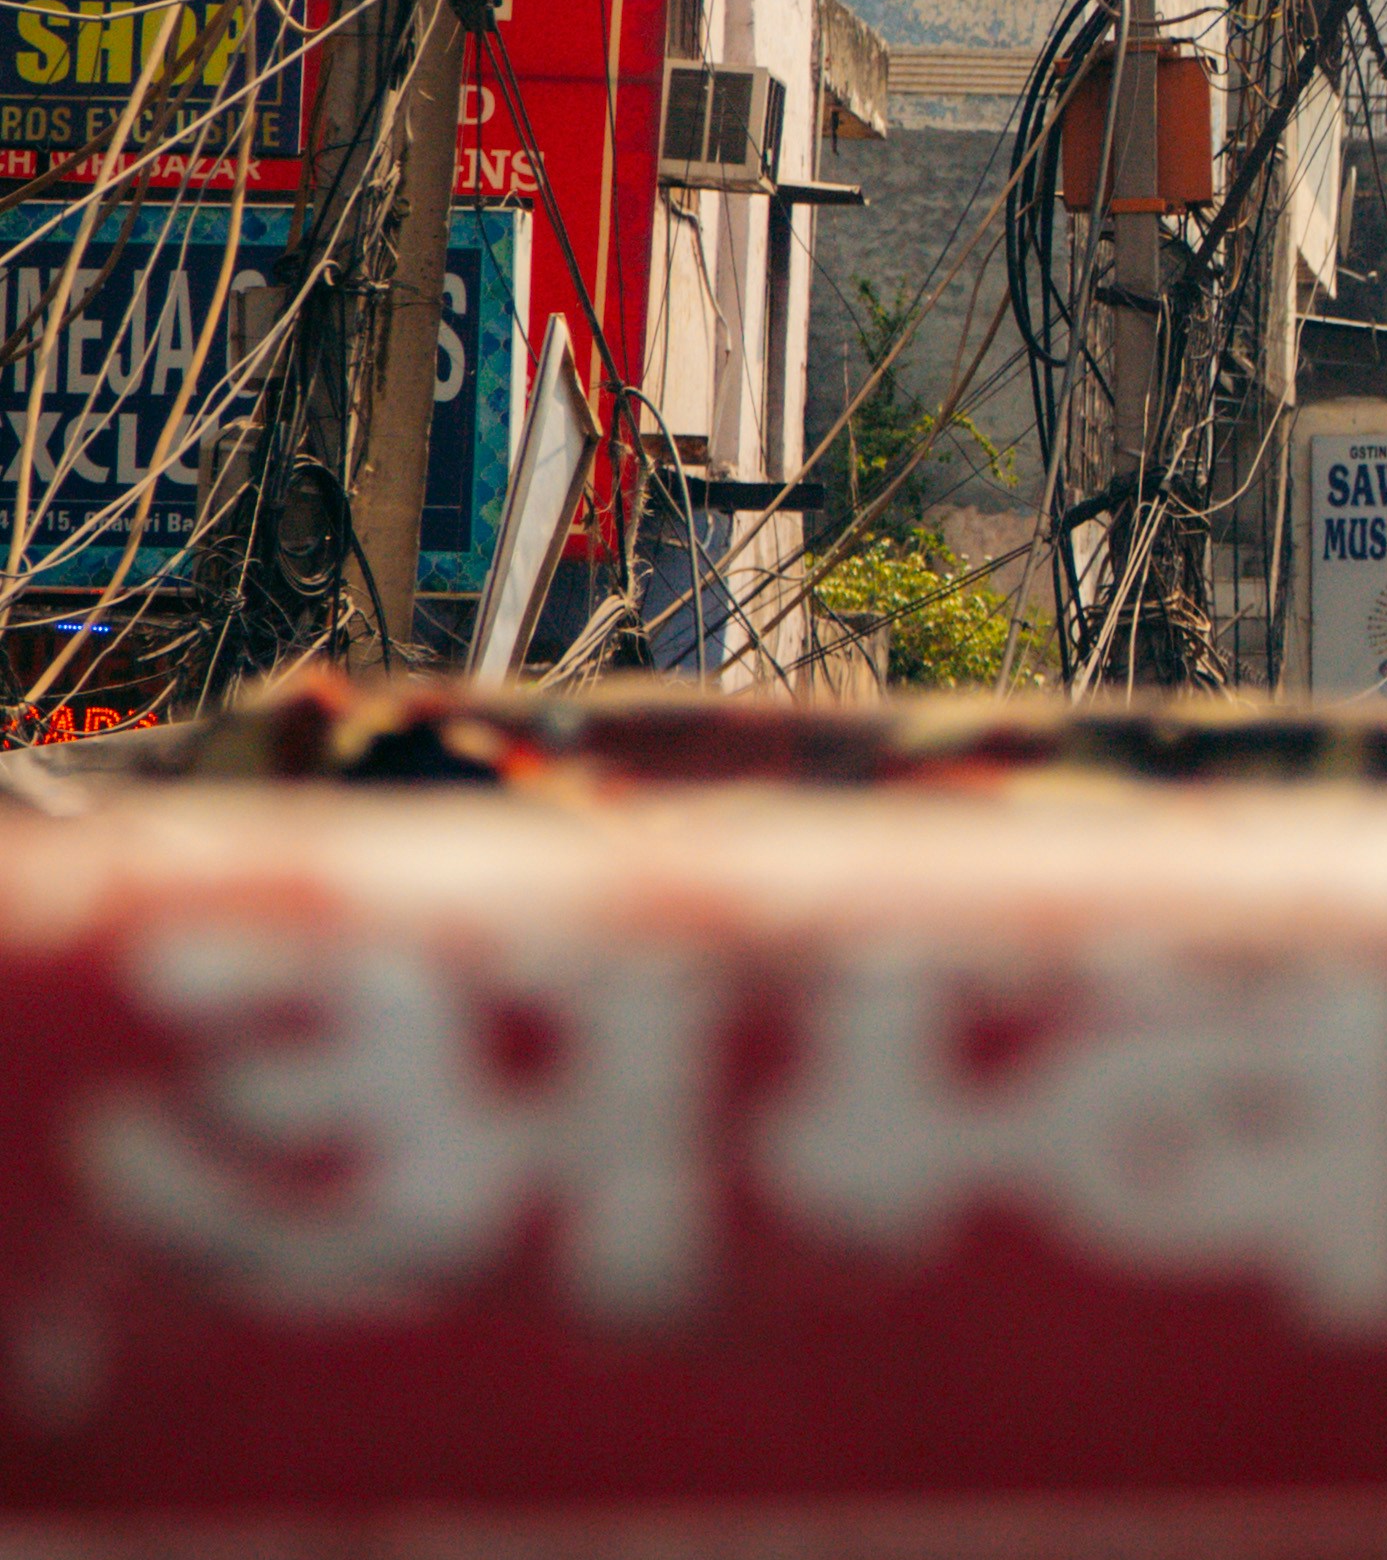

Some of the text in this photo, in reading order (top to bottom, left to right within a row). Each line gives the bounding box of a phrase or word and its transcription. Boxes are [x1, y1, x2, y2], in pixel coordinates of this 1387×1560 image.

[87, 106, 281, 148] EXCLUSIVE
[453, 148, 544, 192] NS
[1349, 444, 1387, 460] GSTIN
